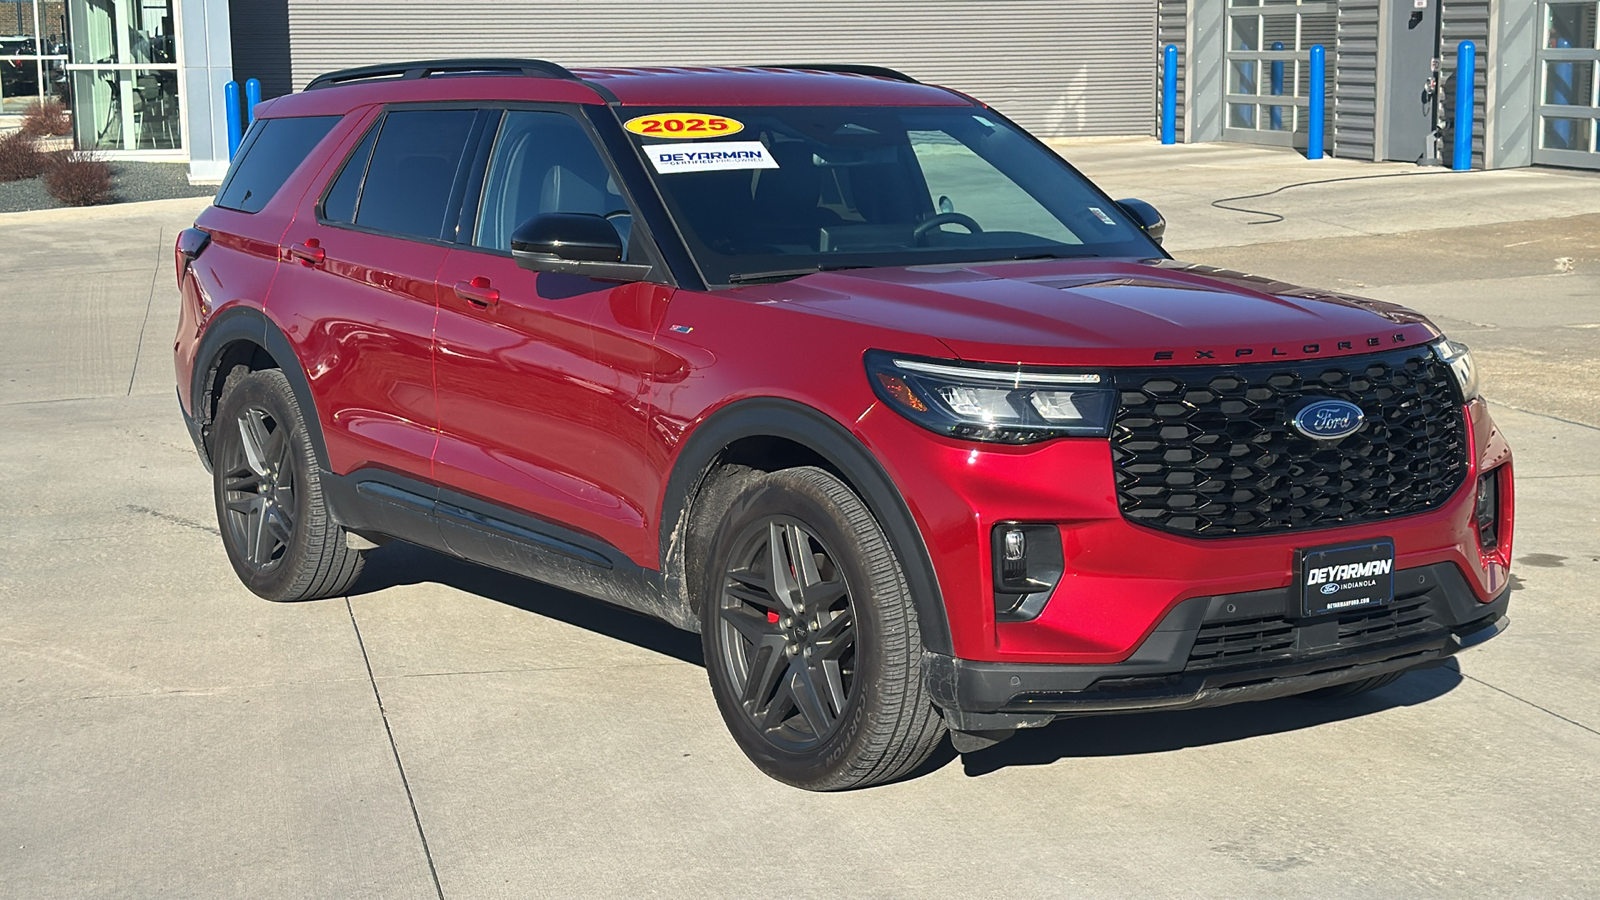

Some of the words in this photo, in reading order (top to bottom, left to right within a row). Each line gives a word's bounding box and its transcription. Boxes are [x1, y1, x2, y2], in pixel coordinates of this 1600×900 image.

[641, 118, 730, 133] 2025
[659, 150, 762, 162] DEYARMAN
[1153, 333, 1406, 361] EXPLORER
[1314, 408, 1351, 431] Ford
[1307, 559, 1393, 586] DEYARMAN
[1340, 579, 1377, 590] INDIANOLA
[825, 681, 869, 768] SCORPION
